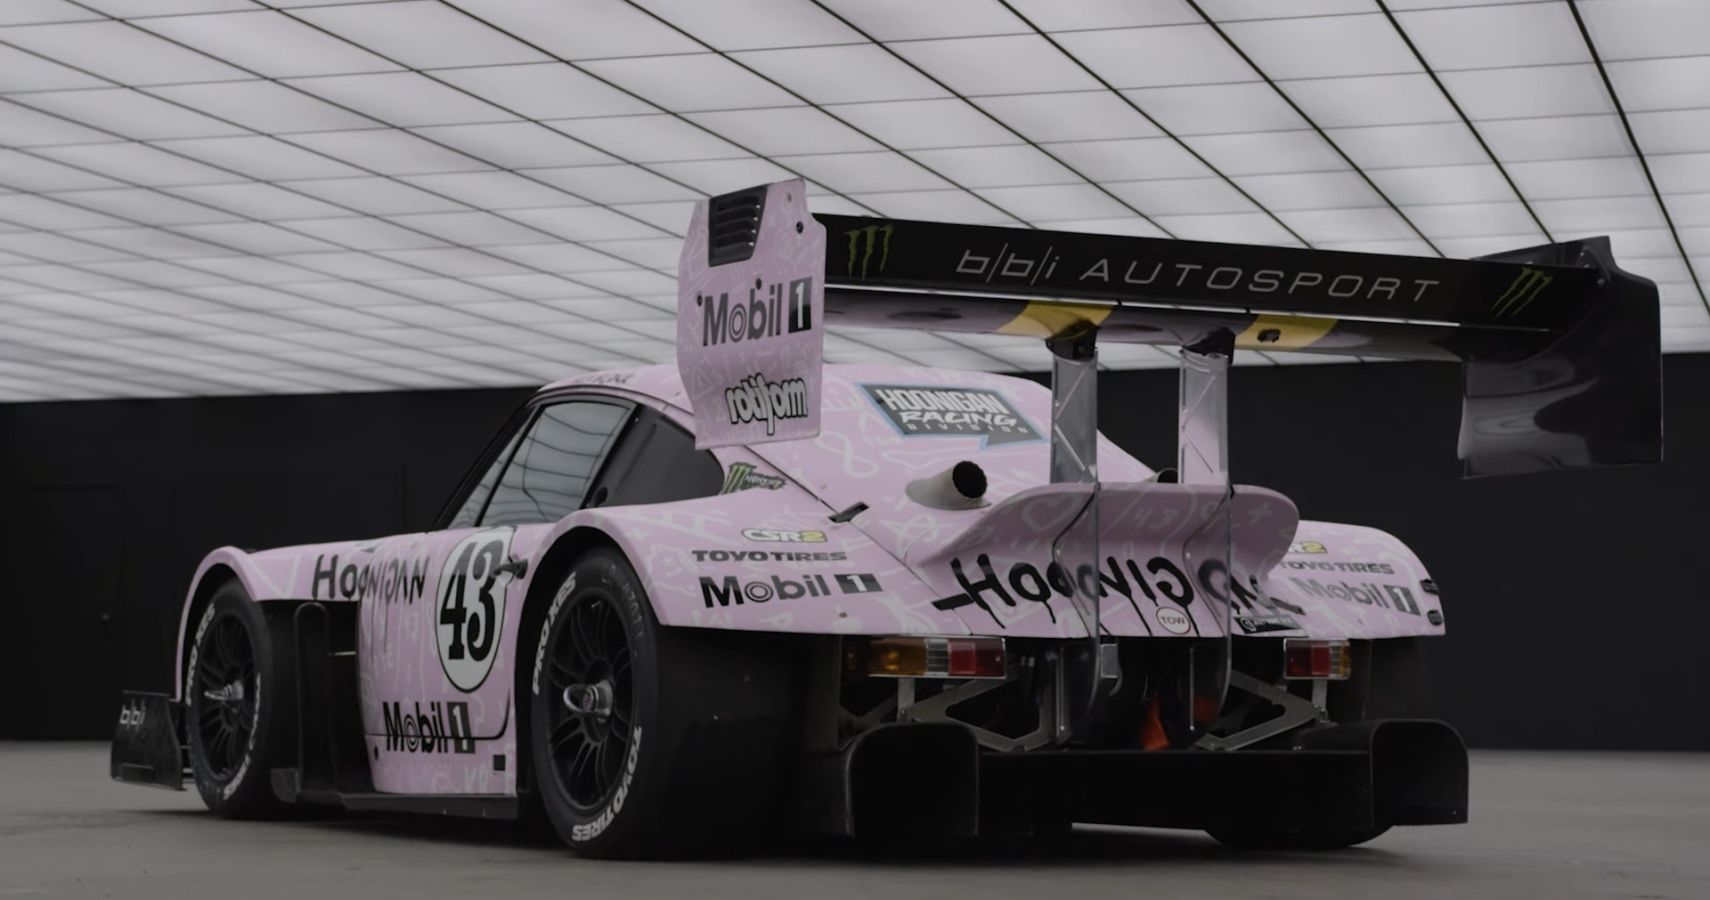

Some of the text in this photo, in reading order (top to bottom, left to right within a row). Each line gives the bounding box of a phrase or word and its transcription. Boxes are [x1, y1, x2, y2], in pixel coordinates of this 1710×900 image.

[1079, 257, 1440, 303] AUTOSPORT
[702, 282, 783, 347] Mobil
[724, 372, 808, 436] rotiform
[875, 388, 1011, 415] HOONIGAN
[898, 410, 1017, 427] RACING
[906, 423, 1029, 434] DIVISION
[741, 528, 828, 543] CSR2
[440, 539, 504, 662] 43
[698, 574, 832, 608] Mobil
[1289, 577, 1390, 609] Mobil
[1160, 615, 1186, 625] TOW
[382, 702, 449, 753] Mobil
